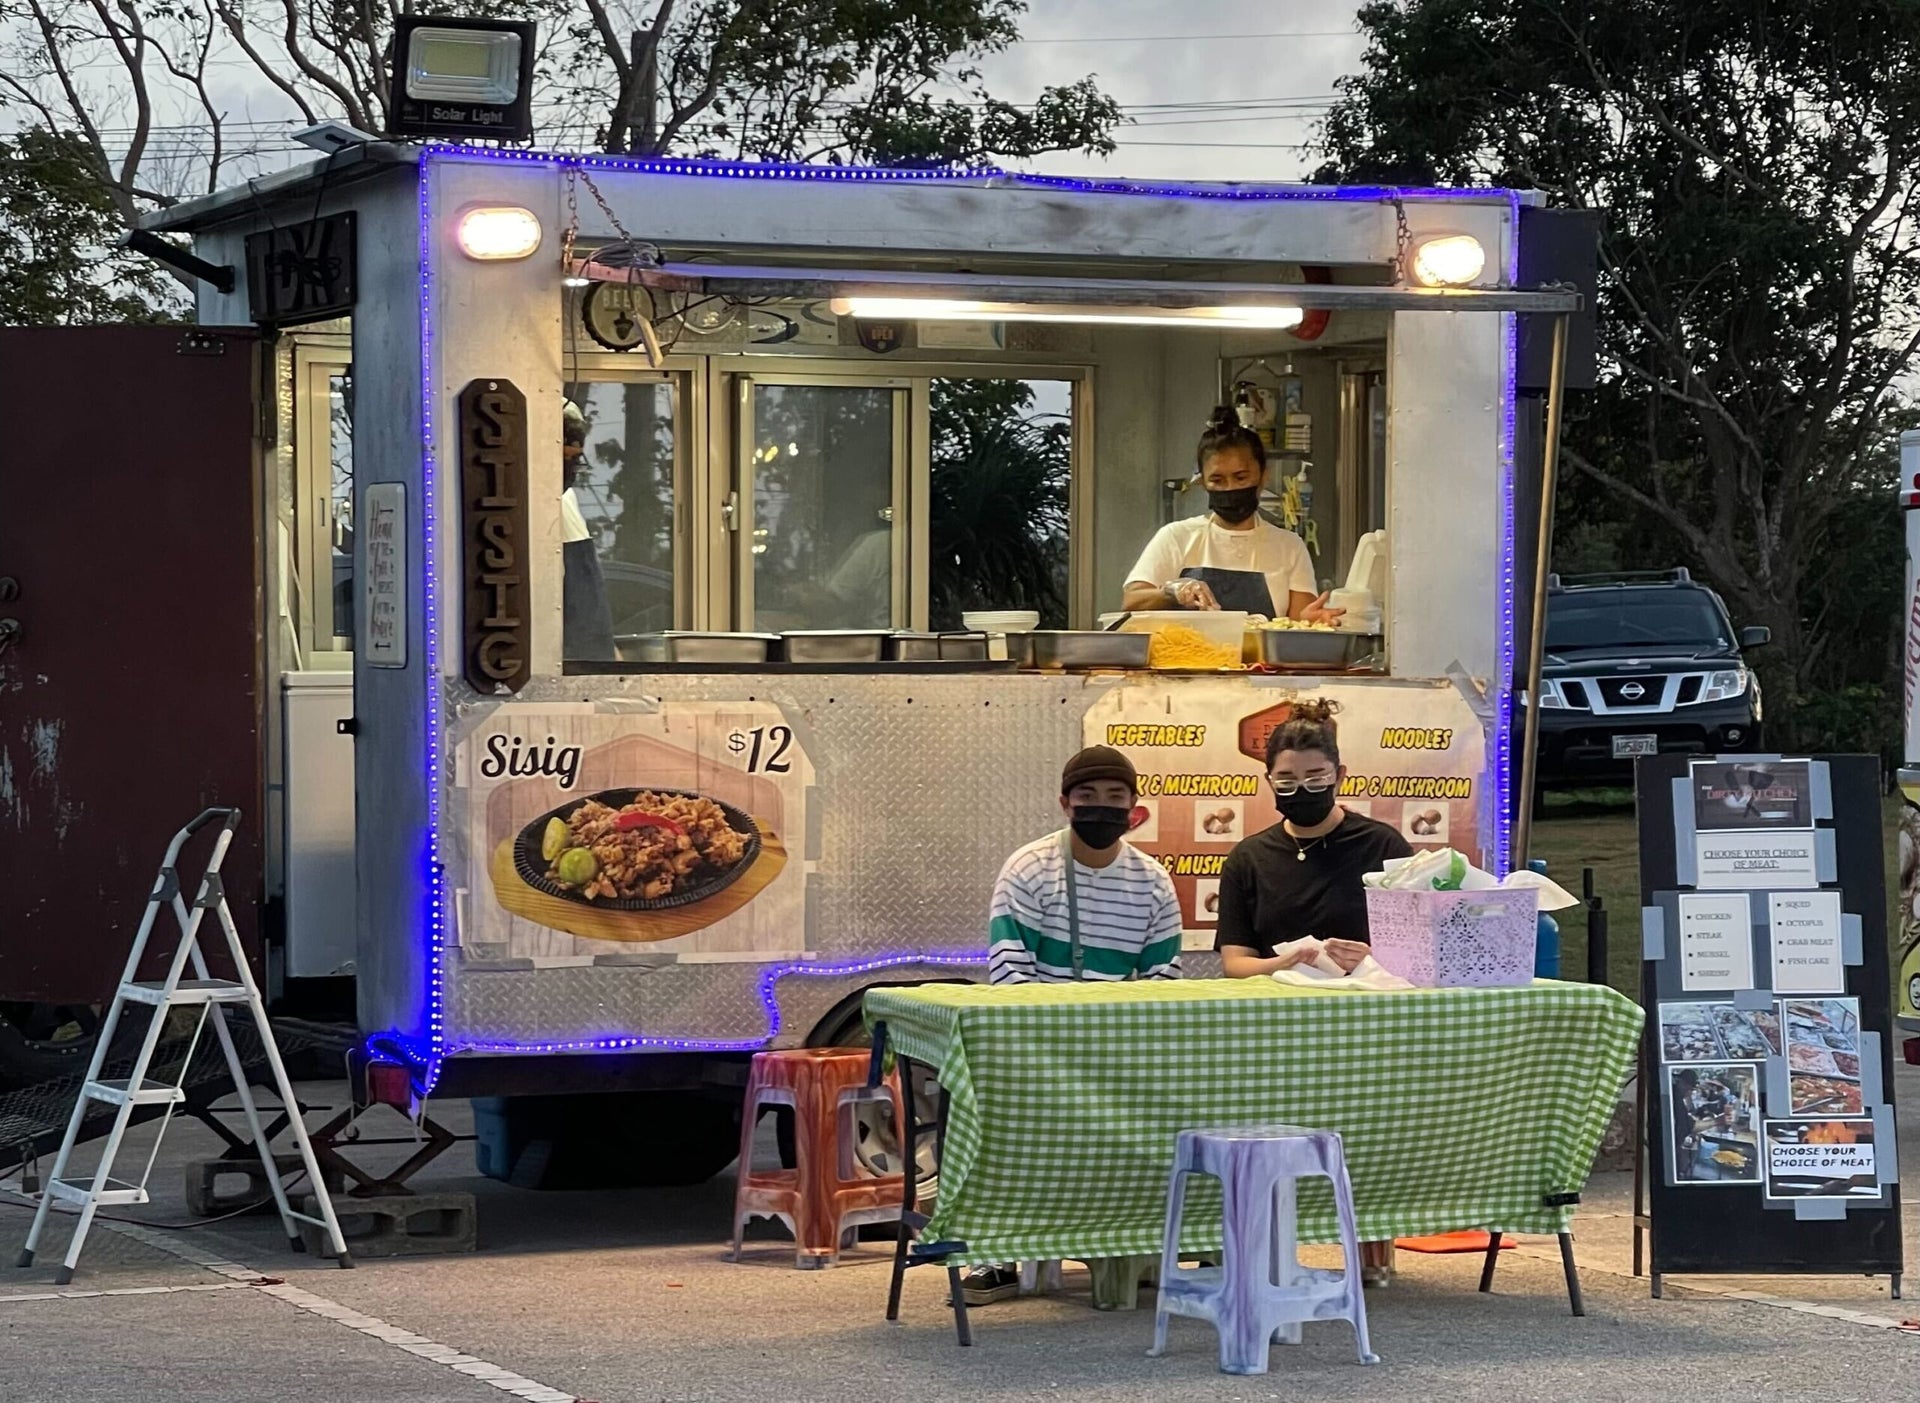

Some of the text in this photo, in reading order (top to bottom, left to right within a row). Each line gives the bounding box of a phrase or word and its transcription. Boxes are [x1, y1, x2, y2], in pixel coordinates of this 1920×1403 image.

[432, 106, 466, 120] Solar
[472, 108, 503, 125] Light
[478, 392, 523, 680] SISIG
[1107, 724, 1206, 747] VEGETABLES
[1380, 728, 1453, 750] NOODLES
[727, 726, 792, 773] $12
[481, 734, 581, 789] Sisig
[1149, 774, 1162, 796] &
[1163, 774, 1258, 798] MUSHROOM
[1338, 776, 1471, 799] MP & MUSHROOM
[1703, 848, 1809, 859] CHOOSE YOUR CHOICE
[1733, 860, 1747, 869] OF
[1785, 919, 1824, 927] OCTOPUS
[1696, 931, 1723, 939] STEAK
[1787, 938, 1834, 946] CRAB MEAT
[1772, 1147, 1857, 1156] CHOOSE YOUR
[1773, 1158, 1873, 1167] CHOICE OF MEAT
